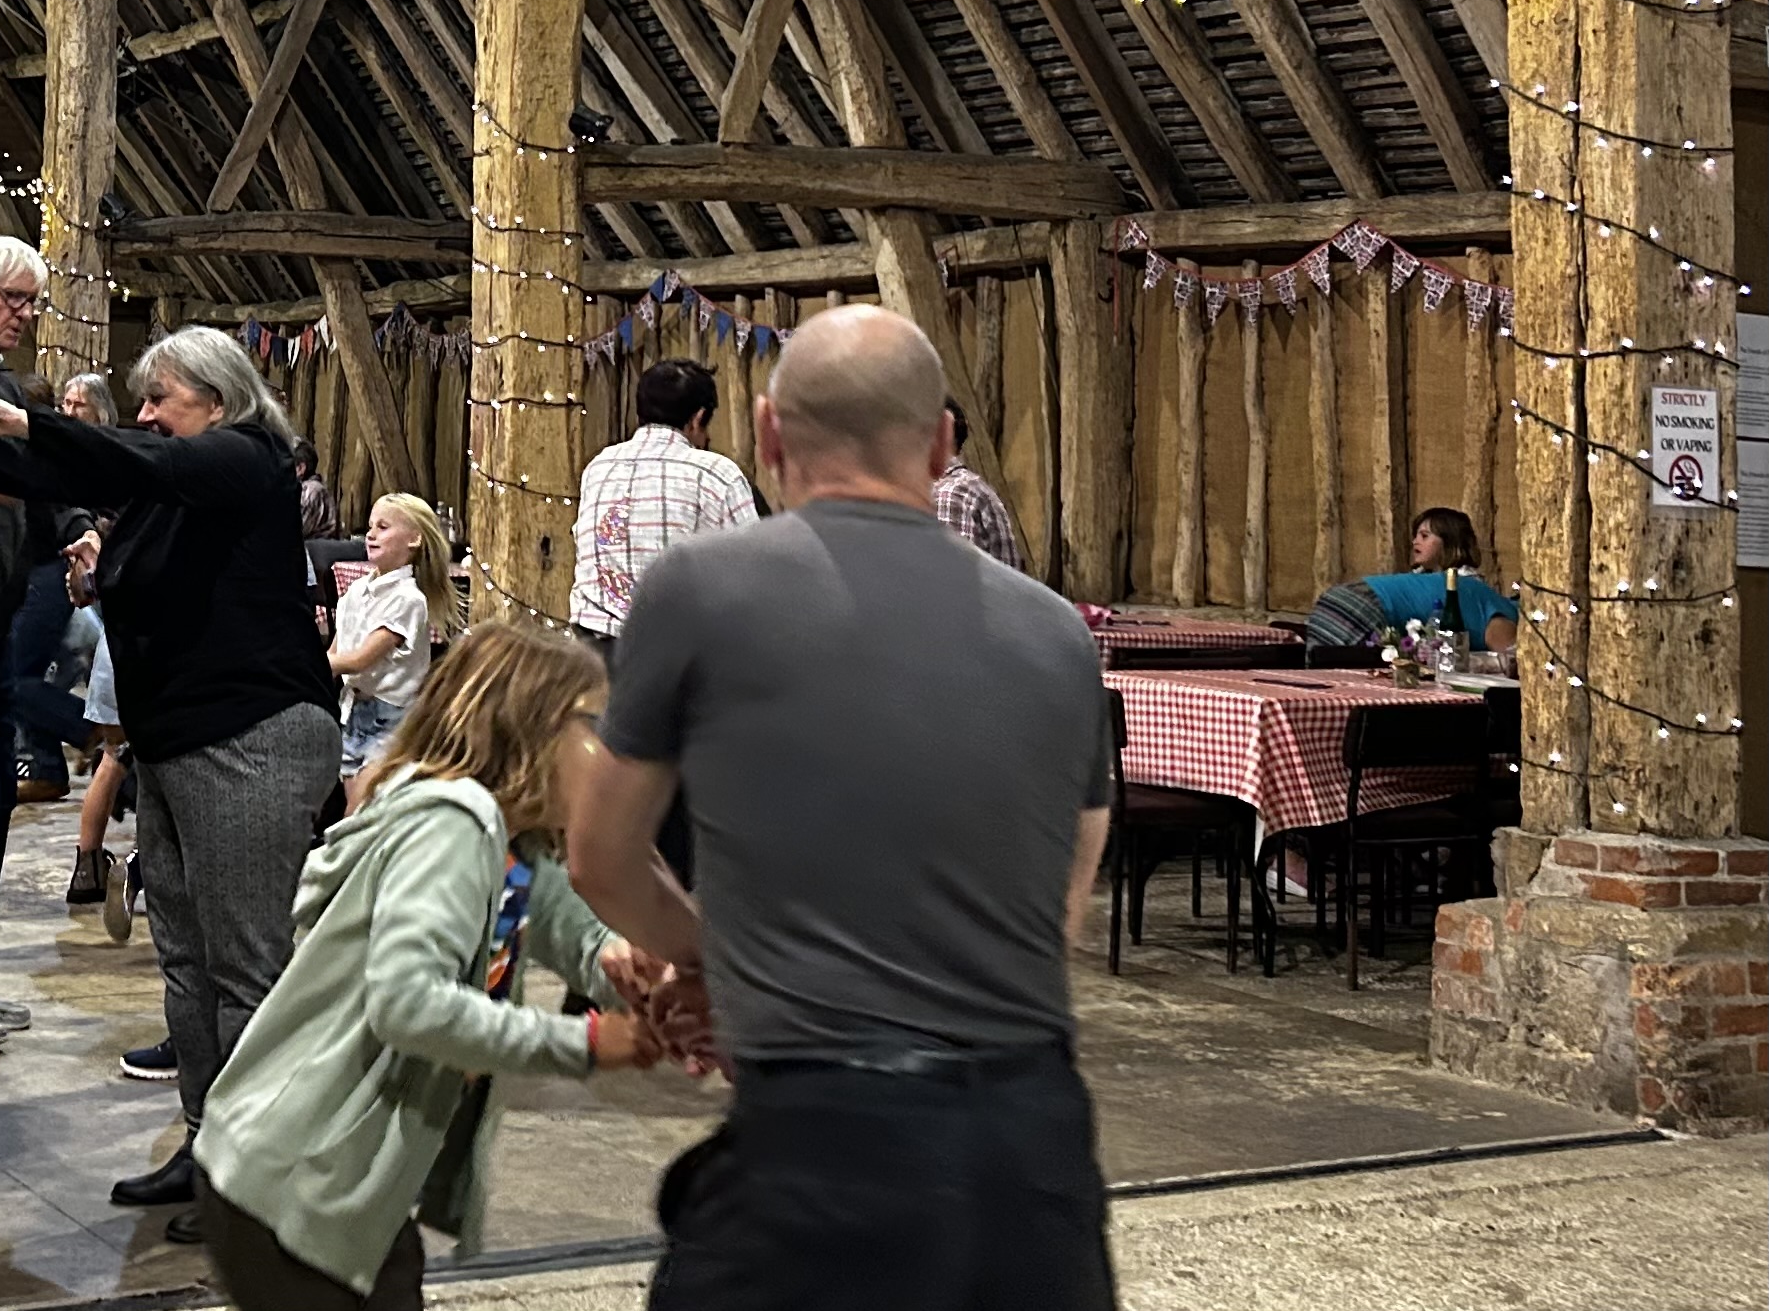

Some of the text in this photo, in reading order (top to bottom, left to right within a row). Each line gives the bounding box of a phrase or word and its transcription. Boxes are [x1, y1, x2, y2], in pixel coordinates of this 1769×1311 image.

[1661, 392, 1706, 406] STRICTLY
[1655, 414, 1715, 430] NO SMOKING
[1661, 438, 1712, 452] OR VAPING
